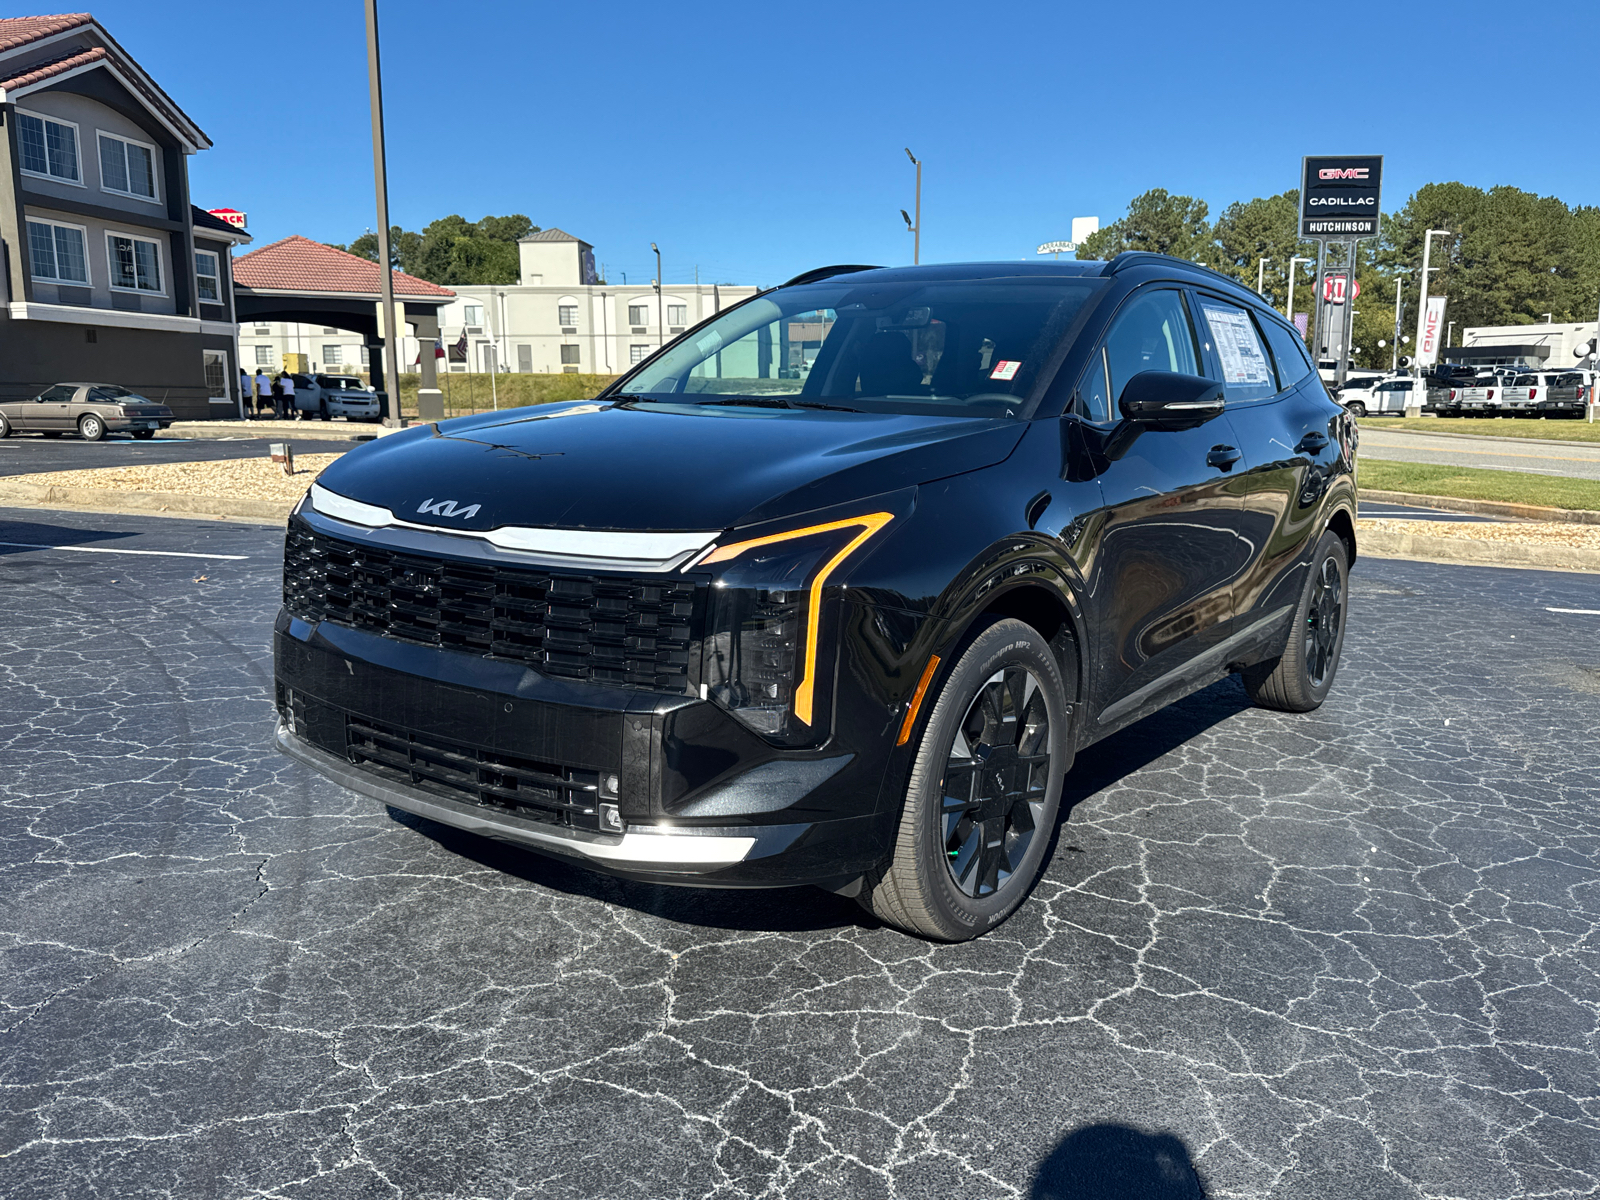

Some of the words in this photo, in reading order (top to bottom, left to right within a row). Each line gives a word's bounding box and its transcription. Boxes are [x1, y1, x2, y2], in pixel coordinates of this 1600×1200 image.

[1319, 168, 1369, 179] GMC
[1309, 197, 1375, 206] CADILLAC
[1309, 222, 1371, 232] HUTCHINSON
[1423, 311, 1438, 353] GMC
[1015, 640, 1031, 650] HP2
